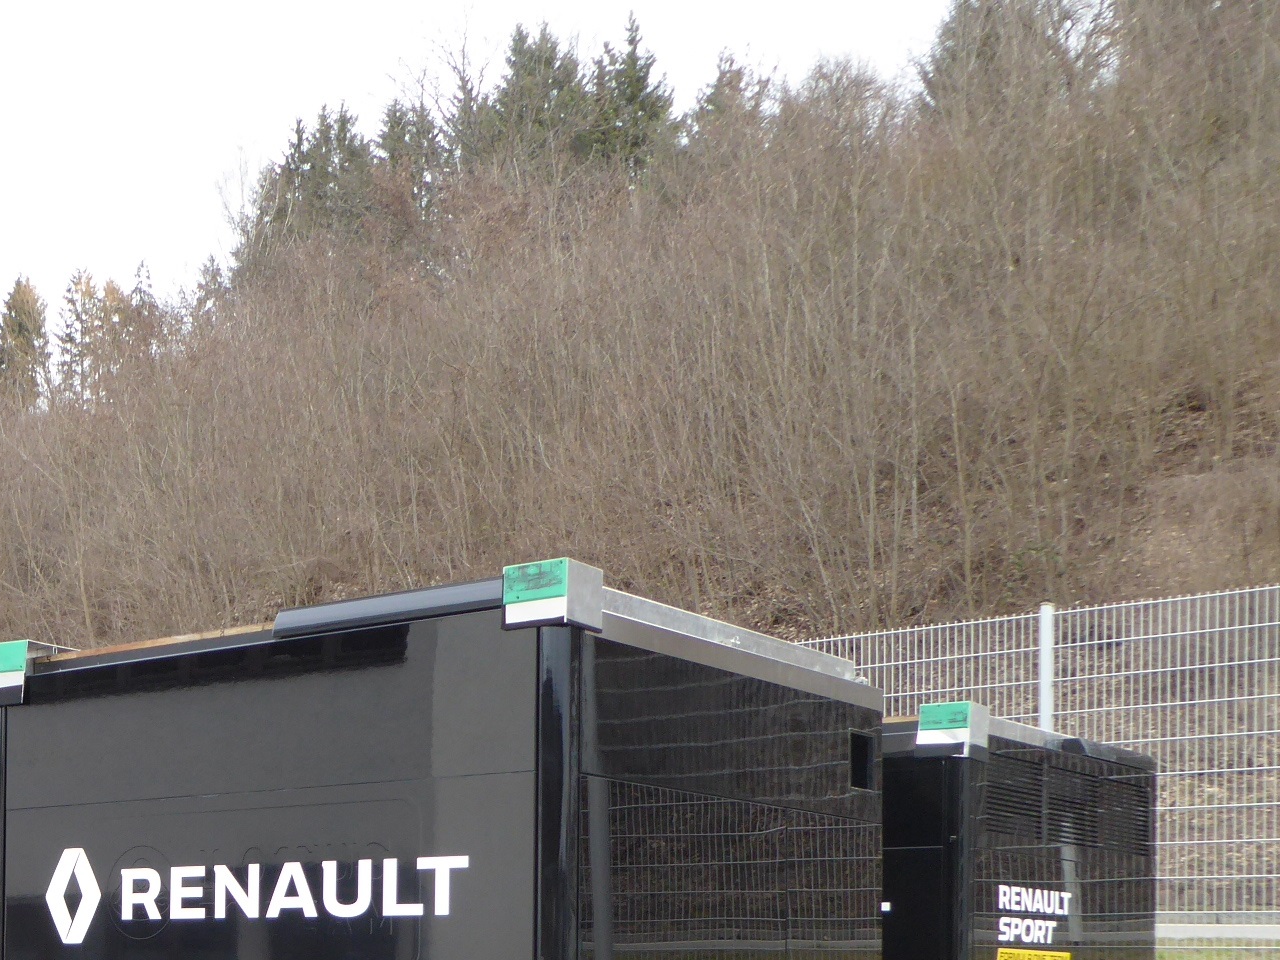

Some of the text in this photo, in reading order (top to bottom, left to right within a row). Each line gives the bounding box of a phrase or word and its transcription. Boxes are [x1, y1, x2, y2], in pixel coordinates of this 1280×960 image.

[121, 855, 470, 921] RENAULT
[998, 885, 1072, 915] RENAULT
[998, 917, 1057, 944] SPORT
